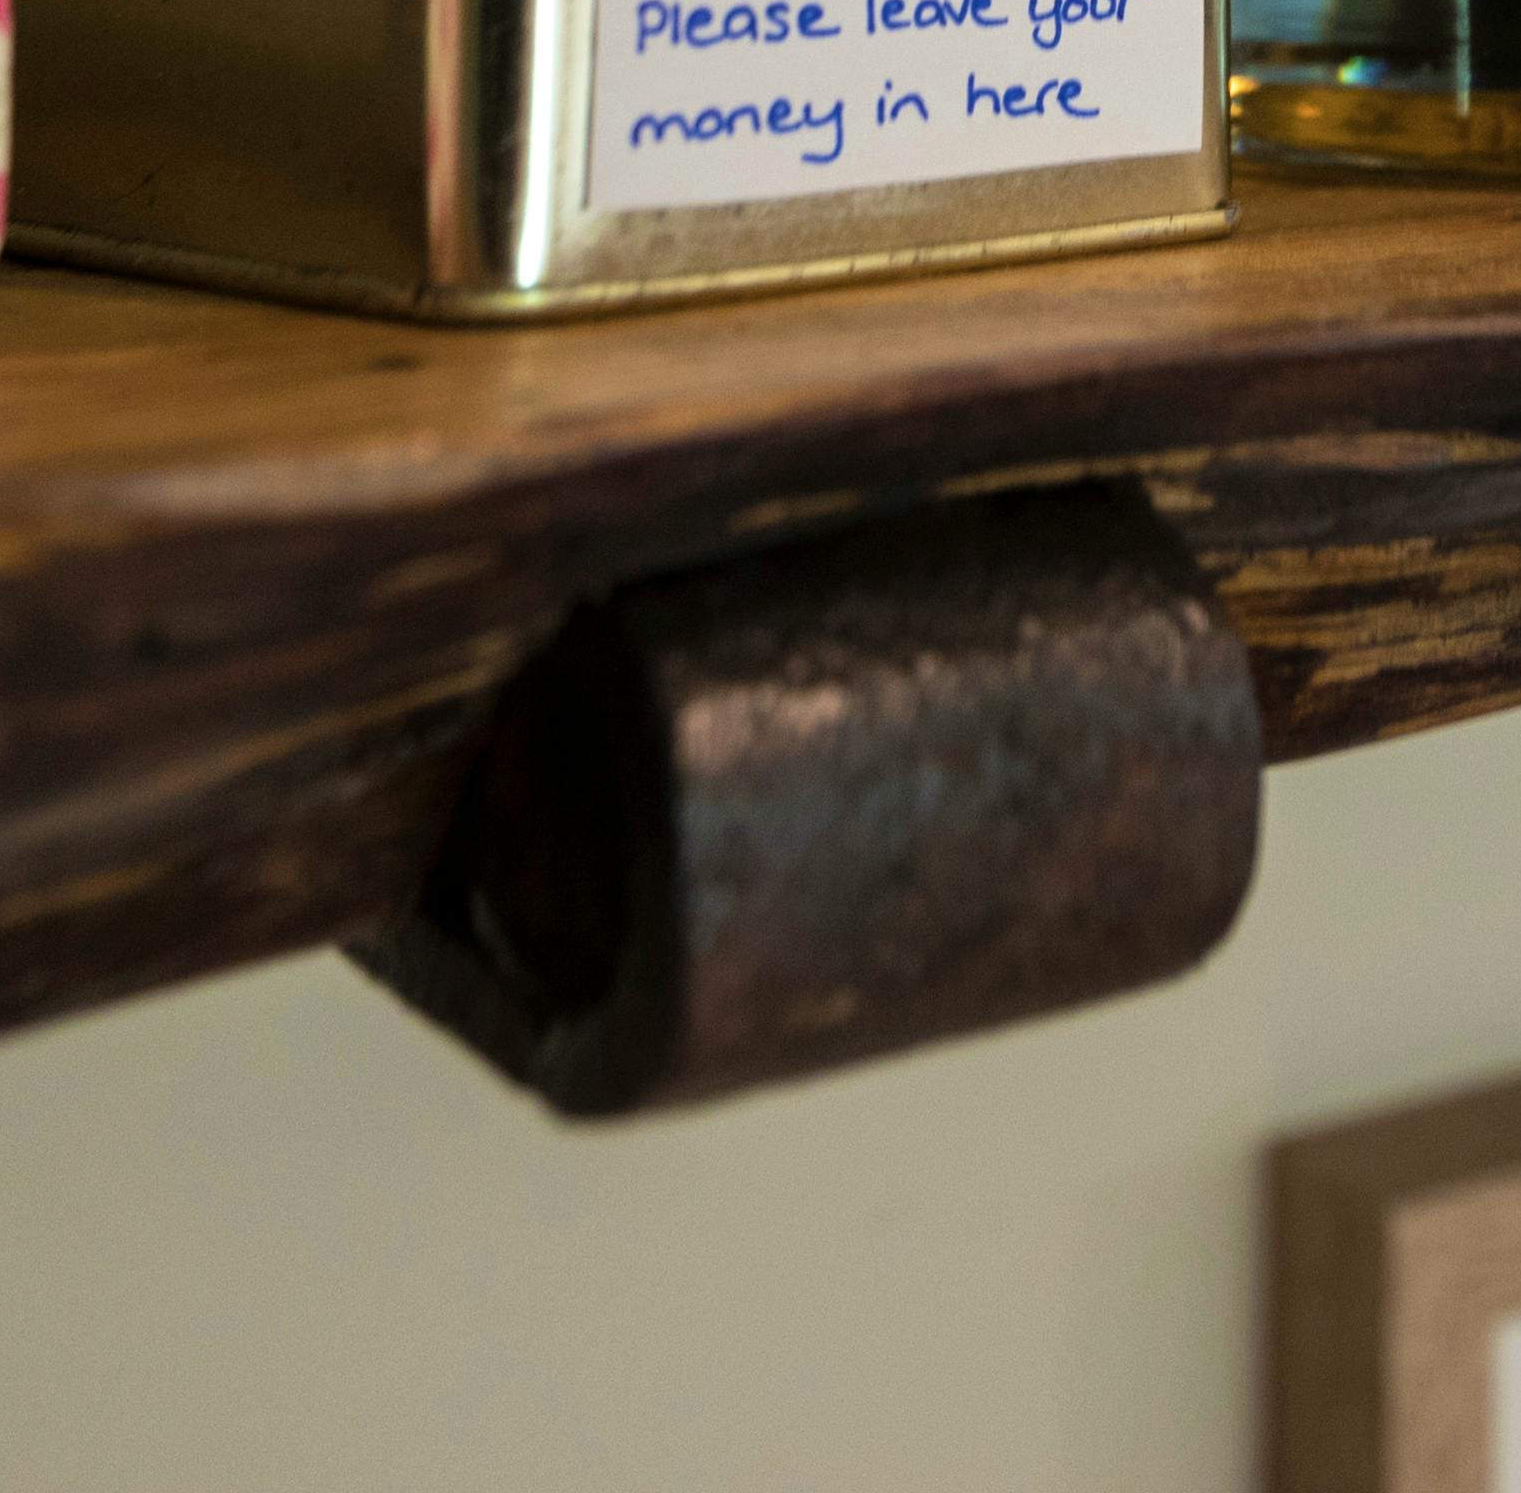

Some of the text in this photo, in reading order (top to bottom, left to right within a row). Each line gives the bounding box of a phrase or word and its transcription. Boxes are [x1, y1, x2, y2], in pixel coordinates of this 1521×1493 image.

[628, 69, 1101, 165] money in here
